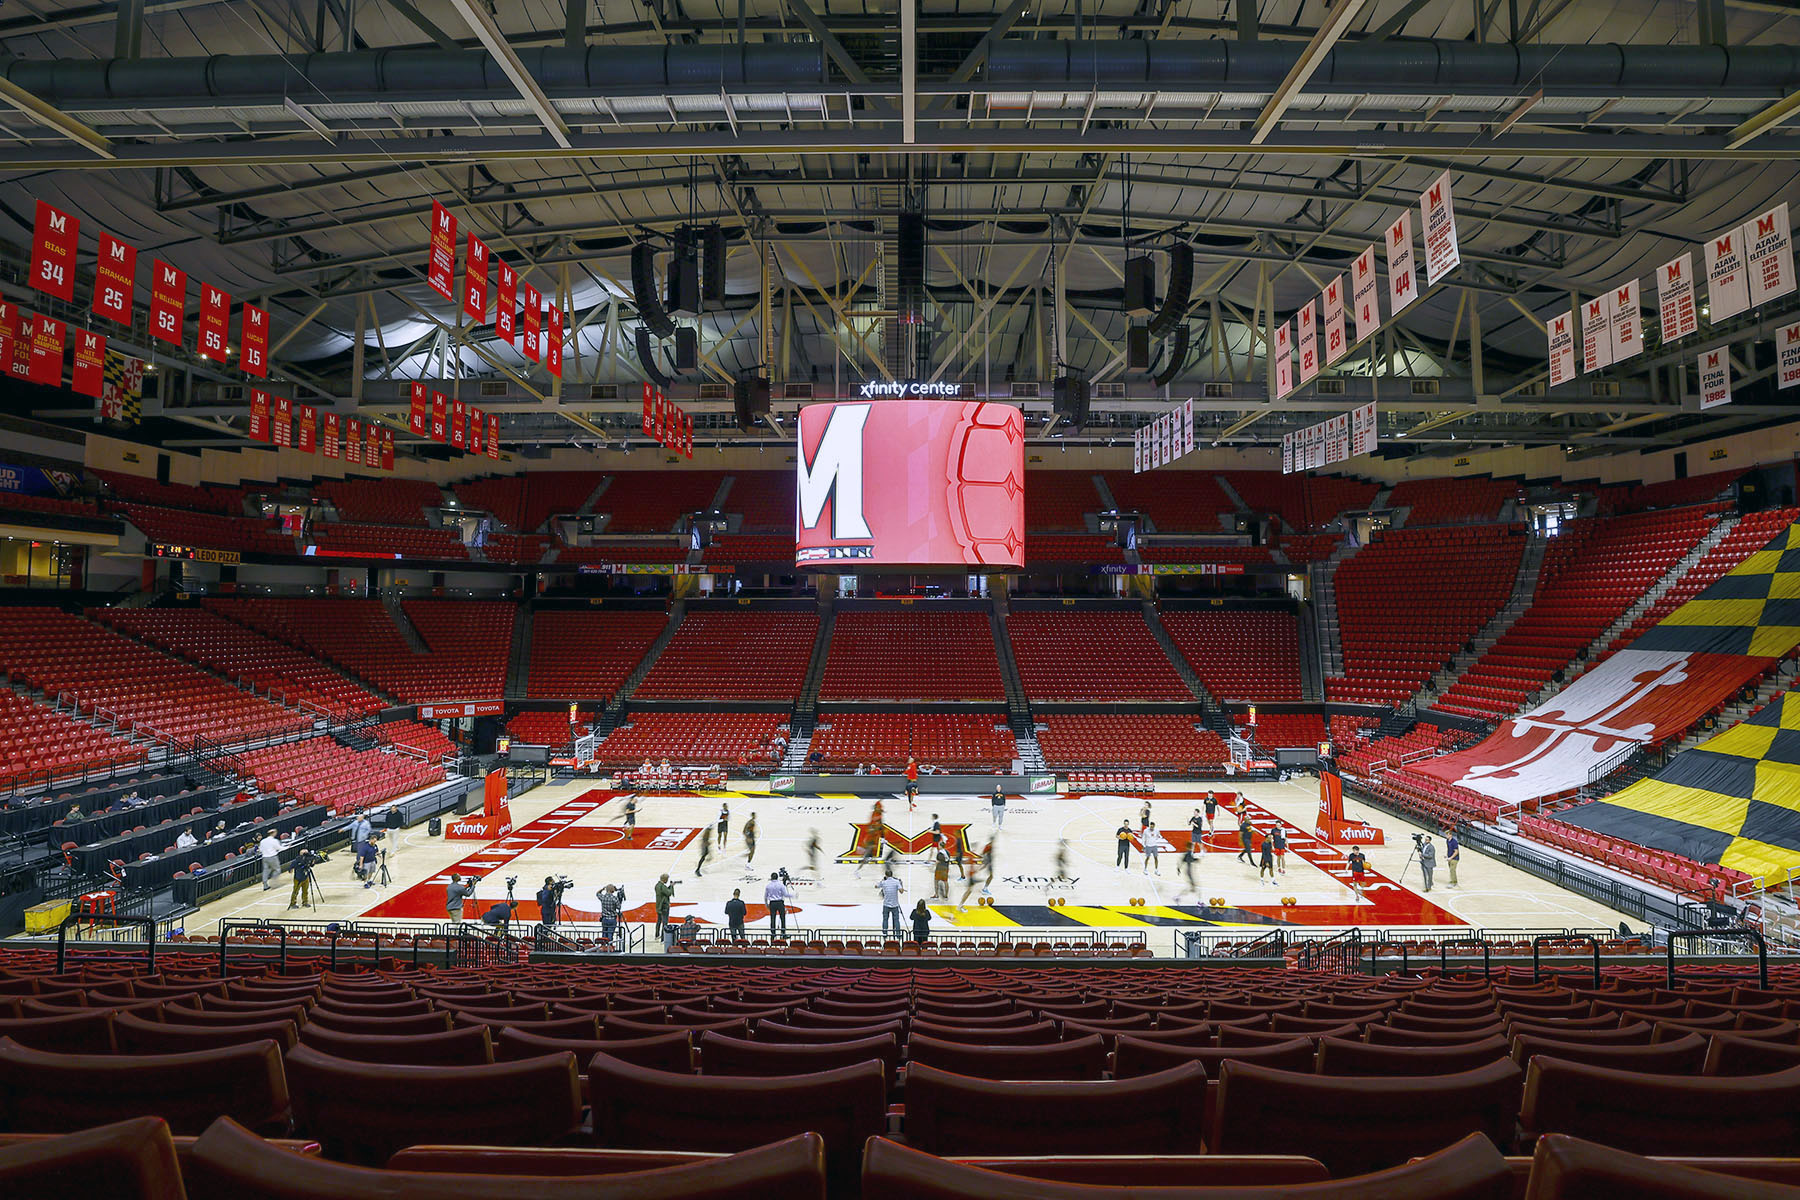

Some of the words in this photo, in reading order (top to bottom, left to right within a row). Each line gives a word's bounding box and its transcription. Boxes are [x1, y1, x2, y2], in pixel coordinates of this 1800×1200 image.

[1429, 183, 1442, 209] M
[49, 210, 66, 233] M
[440, 210, 450, 232] M
[1430, 205, 1446, 222] CHRIS
[1428, 213, 1447, 232] WELLER
[1757, 214, 1775, 237] M
[1392, 220, 1404, 244] M
[44, 240, 67, 256] BIAS
[474, 240, 483, 261] M
[1716, 235, 1731, 257] M
[1750, 248, 1768, 262] ELITE
[1768, 239, 1788, 254] EIGHT
[1754, 233, 1780, 252] AIAW
[110, 241, 126, 262] M
[1358, 255, 1368, 276] M
[1710, 261, 1741, 280] FINALISTS
[1714, 254, 1737, 271] AIAW
[41, 260, 64, 285] 34
[99, 266, 132, 286] GRAHAM
[164, 267, 176, 286] M
[504, 268, 512, 286] M
[1667, 262, 1680, 281] M
[1328, 283, 1337, 302] M
[1396, 271, 1410, 297] 44
[1660, 280, 1691, 298] TOURNAMENT
[104, 288, 123, 310] 25
[210, 290, 222, 307] M
[470, 288, 481, 310] 21
[530, 290, 537, 308] M
[1618, 287, 1630, 305] M
[1662, 287, 1690, 302] CHAMPIONS
[251, 309, 261, 326] M
[552, 310, 560, 326] M
[1303, 308, 1310, 325] M
[1364, 304, 1370, 323] 4
[1590, 301, 1600, 318] M
[43, 320, 56, 335] M
[158, 310, 175, 332] 52
[207, 315, 222, 327] KING
[500, 312, 511, 332] 25
[1555, 318, 1564, 333] M
[85, 334, 96, 349] M
[206, 330, 220, 350] 55
[526, 331, 537, 350] 35
[1280, 328, 1286, 344] M
[1330, 328, 1341, 351] 23
[14, 340, 30, 351] FIN
[1782, 347, 1800, 359] FINA
[248, 348, 260, 366] 15
[552, 350, 558, 365] 3
[1304, 350, 1313, 370] 22
[1708, 352, 1718, 368] M
[1784, 356, 1800, 367] FOU
[1282, 369, 1286, 386] 1
[1702, 370, 1724, 382] FINAL
[1784, 368, 1800, 382] 198
[861, 381, 908, 398] xfinity
[910, 382, 960, 396] center
[1704, 378, 1724, 390] FOUR
[1704, 390, 1726, 403] 1982
[414, 415, 422, 428] 41
[435, 423, 442, 436] 54
[0, 468, 16, 479] UD
[196, 550, 216, 560] LEDO
[218, 552, 240, 562] PIZZA
[616, 564, 624, 573] M
[678, 564, 686, 573] M
[1101, 564, 1127, 574] xfinity
[1142, 564, 1150, 573] M
[1204, 564, 1213, 573] M
[770, 778, 794, 790] LIBMAN
[1031, 779, 1054, 792] LIBMAN
[452, 822, 488, 836] xfinity
[498, 823, 511, 836] xfinity
[1340, 827, 1376, 840] xfinity
[834, 823, 983, 858] M
